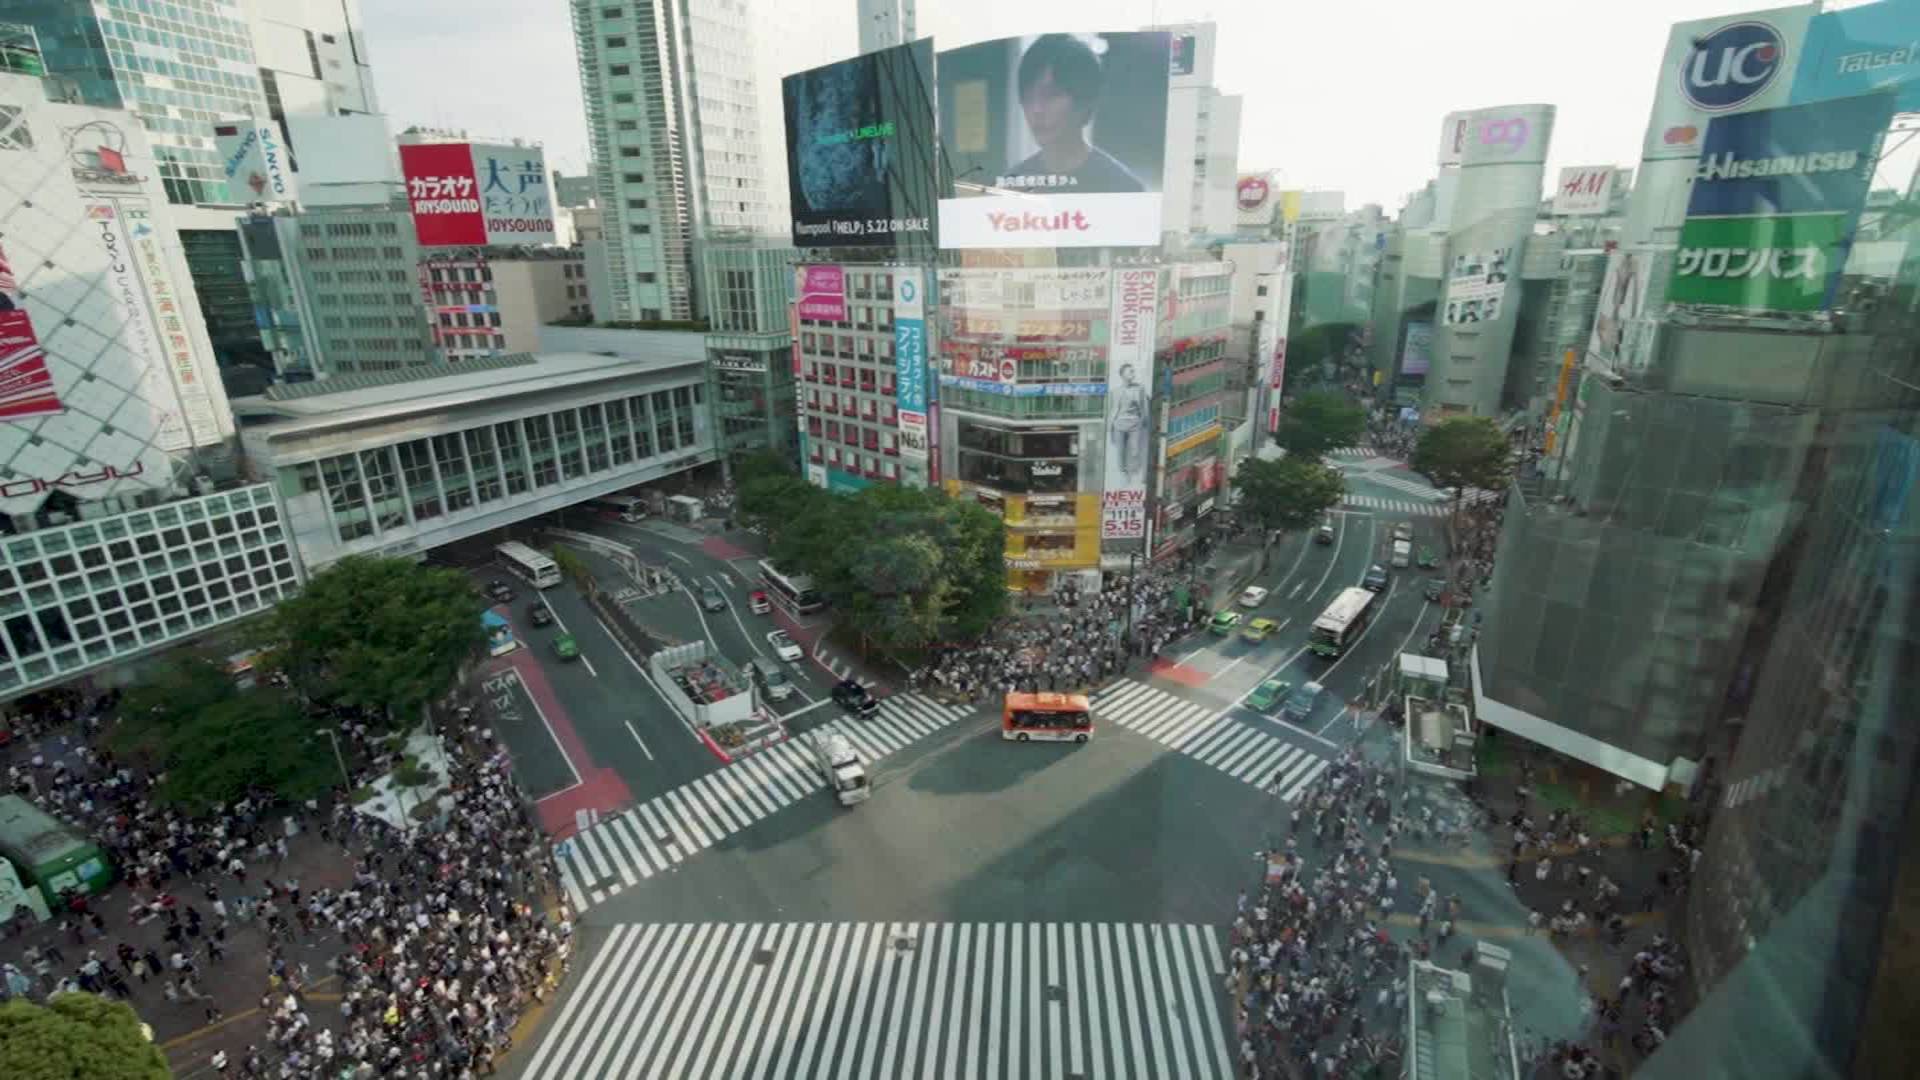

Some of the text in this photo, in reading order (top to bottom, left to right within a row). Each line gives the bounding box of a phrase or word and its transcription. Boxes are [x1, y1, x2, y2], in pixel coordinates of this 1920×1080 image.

[1691, 42, 1775, 87] UC
[259, 128, 285, 193] SANKYO
[410, 176, 473, 198] カラオケ
[415, 199, 479, 214] JOYSOUND
[488, 218, 553, 232] JOYSOUND
[987, 209, 1091, 232] Yakult
[1679, 246, 1821, 280] サロンパス
[1139, 271, 1155, 314] EXILE
[1120, 271, 1140, 345] SHOKICHI
[1105, 490, 1143, 500] NEW
[1105, 520, 1141, 531] 5.15
